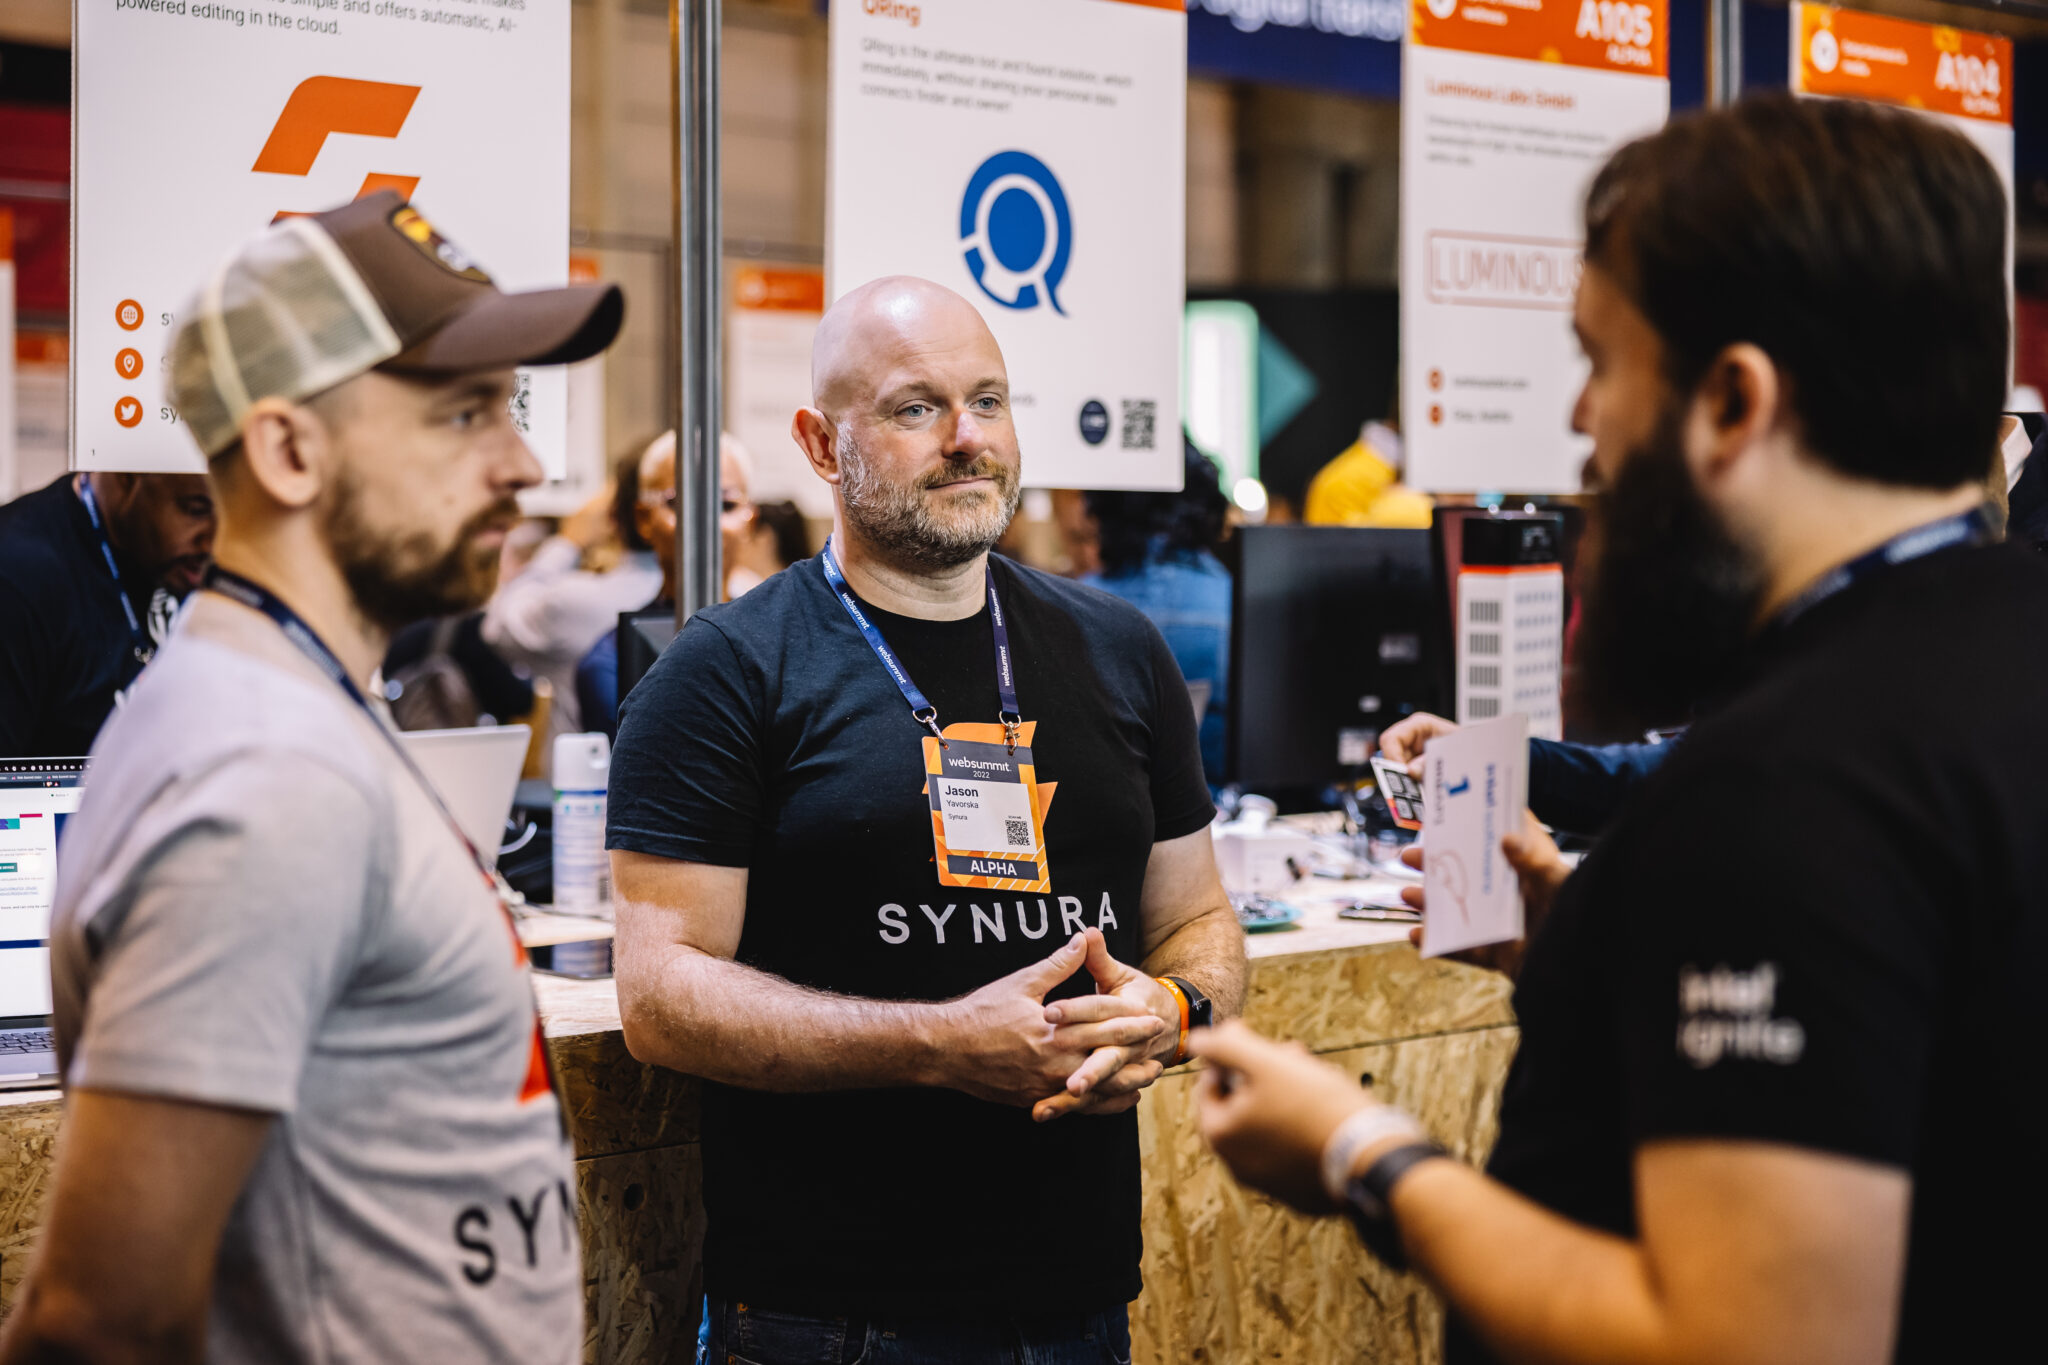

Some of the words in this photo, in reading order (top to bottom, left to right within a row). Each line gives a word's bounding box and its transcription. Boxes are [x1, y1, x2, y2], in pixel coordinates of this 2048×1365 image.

[116, 0, 185, 15] powered
[191, 3, 245, 26] editing
[250, 8, 263, 25] in
[268, 12, 292, 29] the
[297, 16, 342, 36] cloud.
[343, 0, 370, 14] and
[374, 2, 417, 20] offers
[420, 9, 494, 32] automatic,
[1576, 0, 1654, 47] A105
[842, 592, 870, 630] websummit
[877, 645, 907, 685] websummit
[945, 785, 979, 797] Jason
[973, 770, 990, 779] 2022
[946, 799, 979, 809] Yavorska
[970, 860, 1017, 876] ALPHA
[877, 891, 1118, 944] SYNURA
